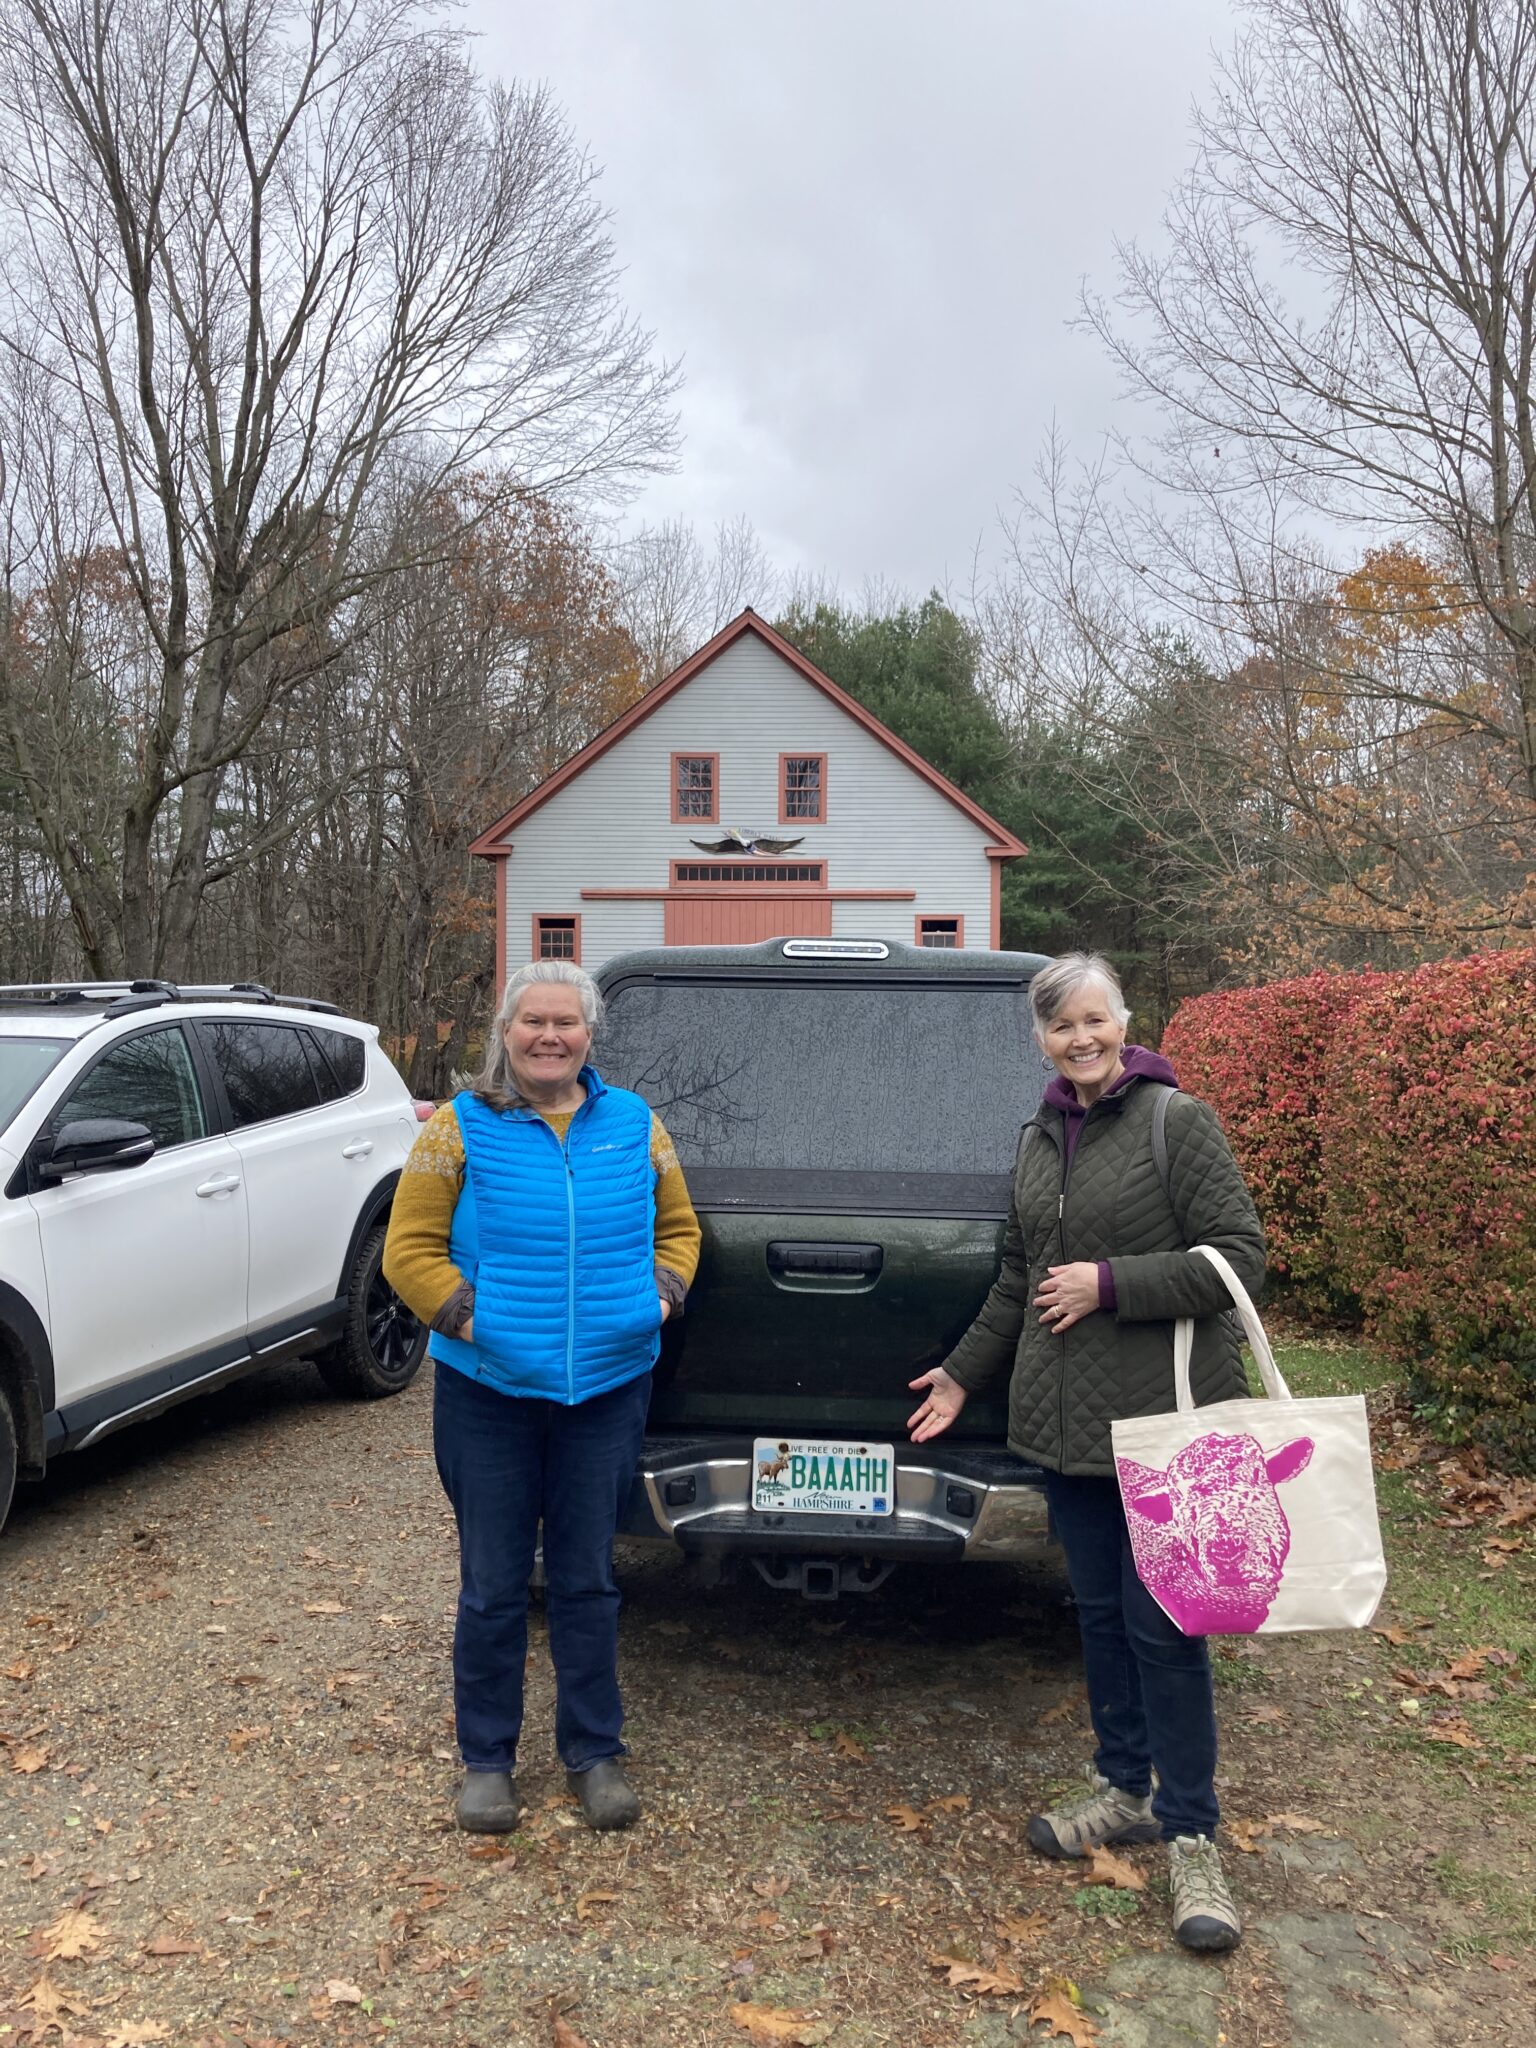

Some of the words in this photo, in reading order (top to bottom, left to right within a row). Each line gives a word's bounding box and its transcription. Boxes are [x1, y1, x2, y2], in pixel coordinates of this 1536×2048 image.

[807, 1446, 828, 1454] FREE
[847, 1447, 861, 1455] DIE
[791, 1455, 888, 1493] BAAAHH
[804, 1491, 841, 1499] New
[793, 1497, 854, 1511] HAMPSHIRE
